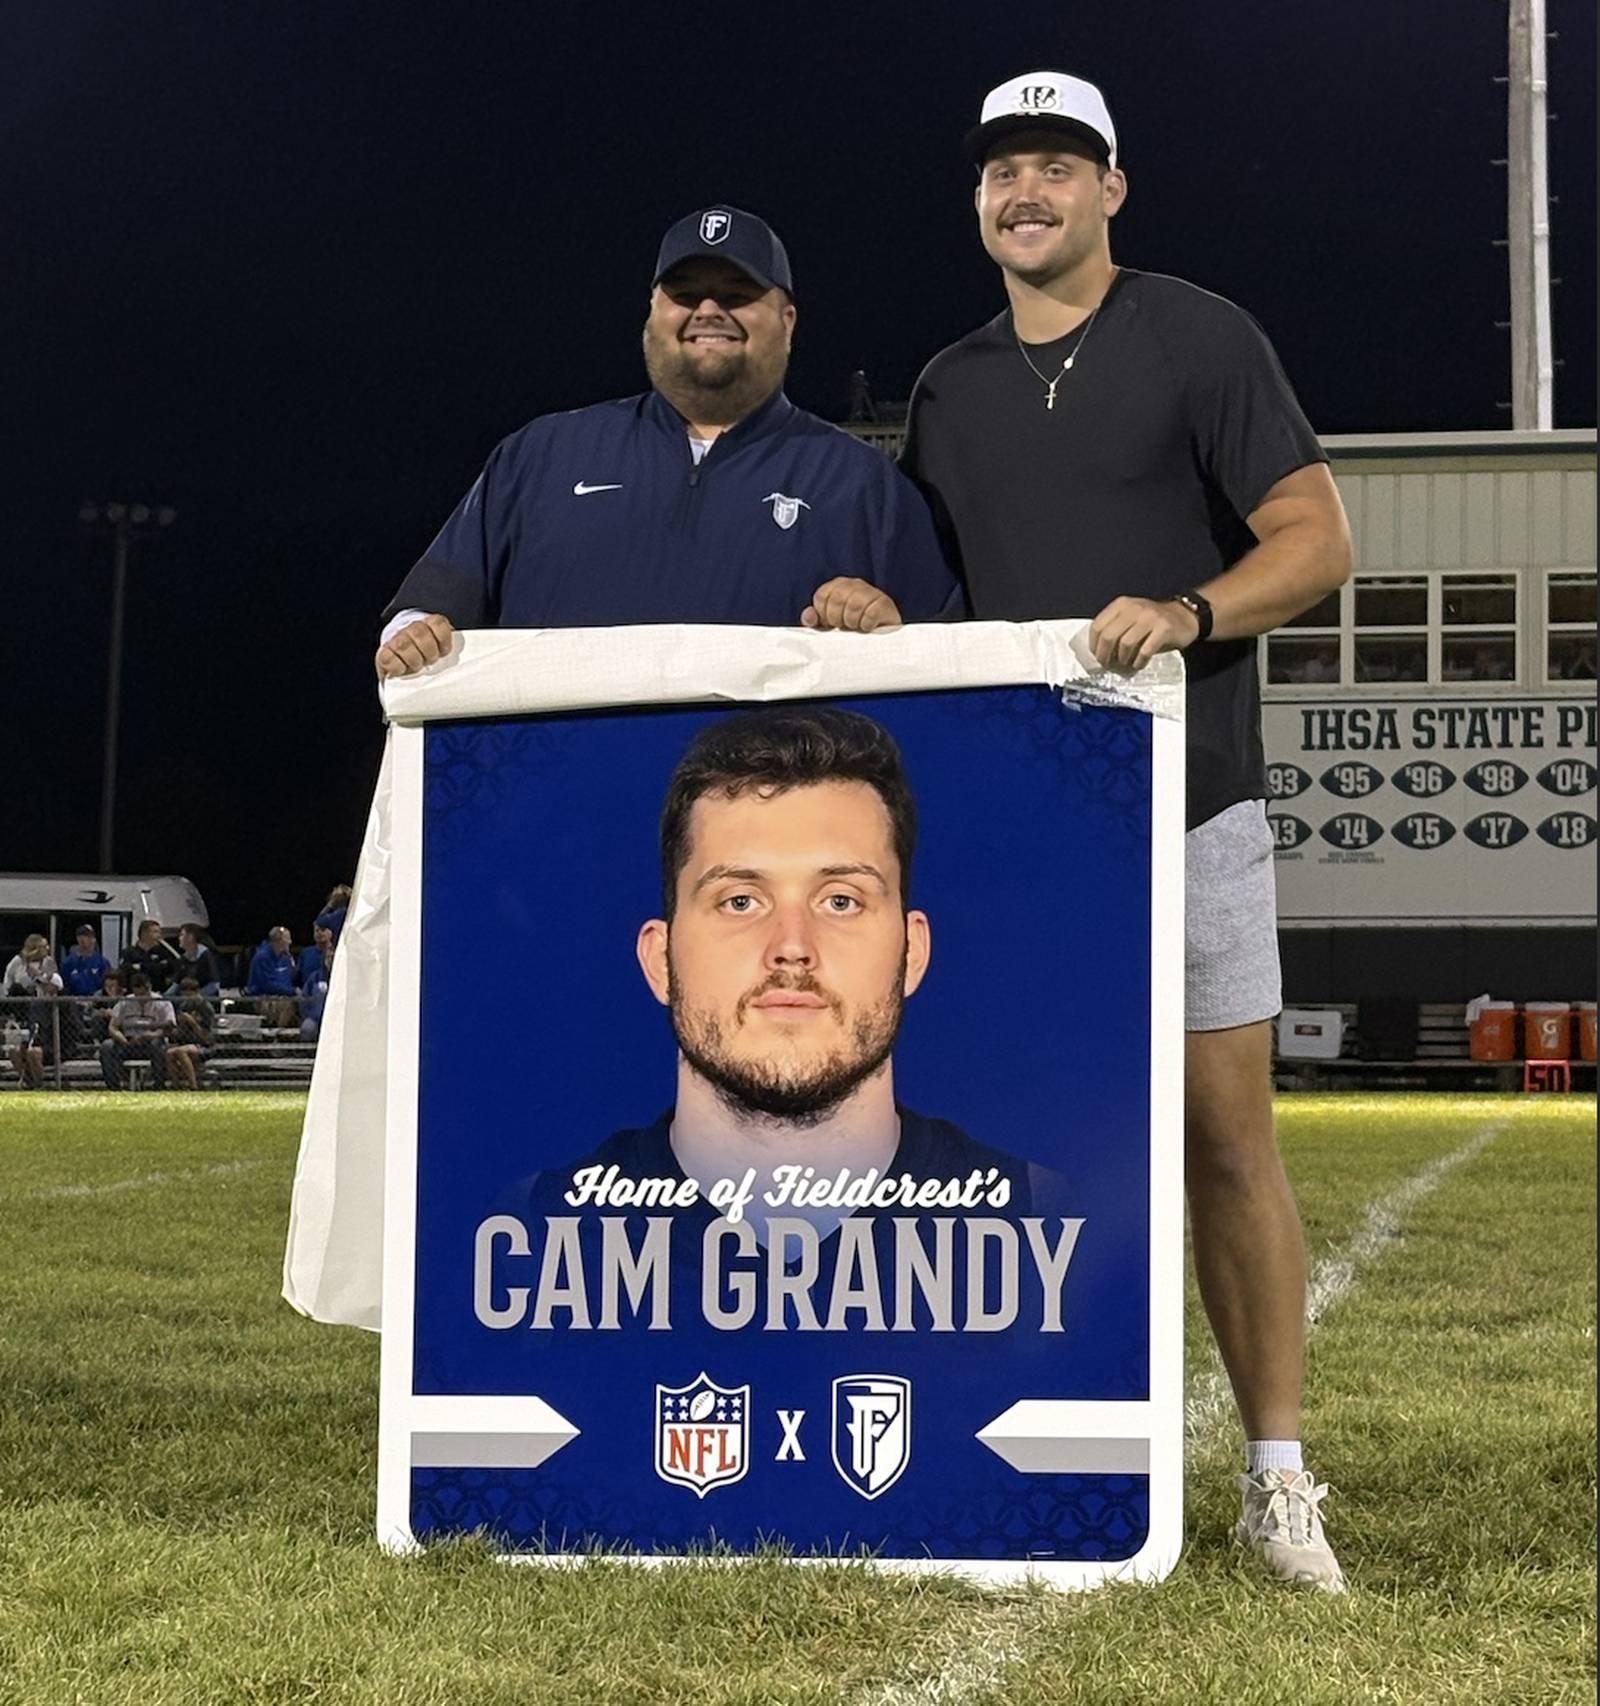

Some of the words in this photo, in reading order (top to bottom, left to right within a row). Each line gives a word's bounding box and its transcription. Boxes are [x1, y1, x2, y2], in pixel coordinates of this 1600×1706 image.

[1301, 708, 1401, 751] IHSA
[1412, 706, 1544, 749] STATE
[1333, 766, 1370, 794] '95
[1405, 765, 1442, 793] '96
[1477, 764, 1514, 792] '98
[1550, 763, 1588, 791] '04
[1335, 818, 1369, 846] '14
[1407, 818, 1440, 845] '15
[1480, 817, 1512, 845] '17
[1551, 816, 1587, 844] '18
[564, 1164, 698, 1208] Home
[709, 1168, 757, 1224] of
[764, 1164, 1011, 1209] Fieldcrest's
[473, 1214, 674, 1331] CAM
[701, 1215, 1087, 1334] GRANDY
[667, 1427, 737, 1478] NFL
